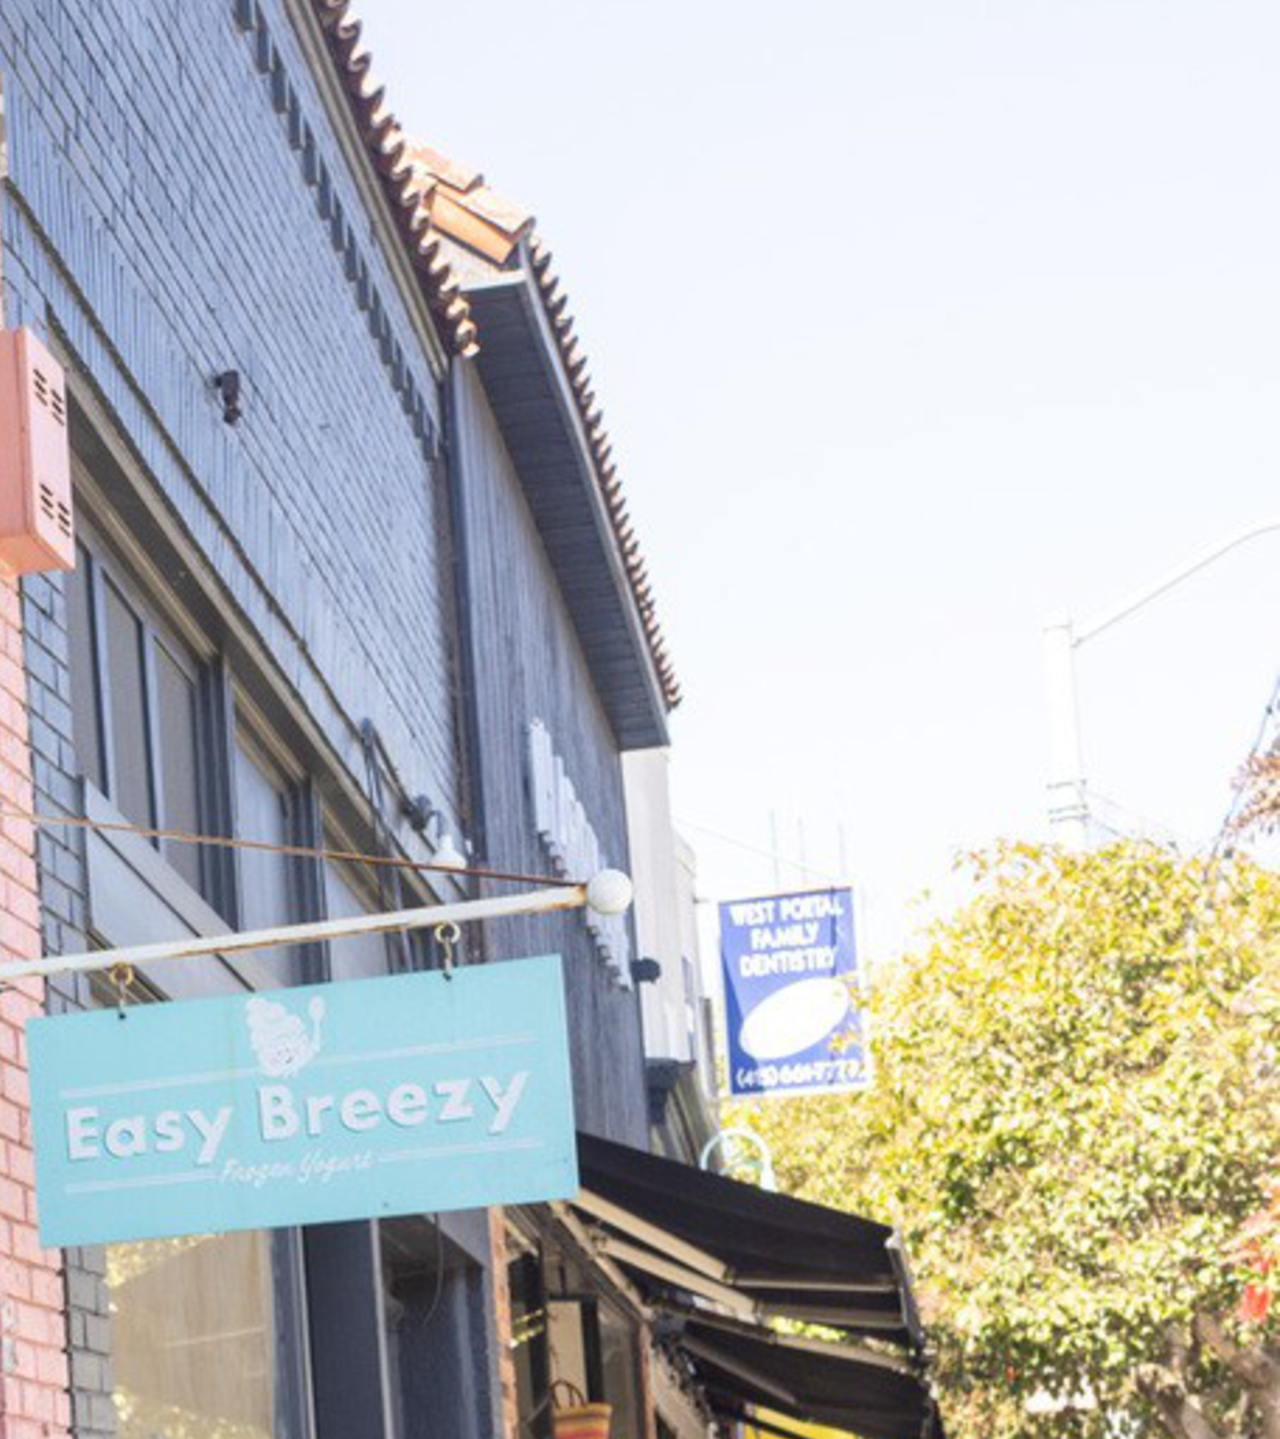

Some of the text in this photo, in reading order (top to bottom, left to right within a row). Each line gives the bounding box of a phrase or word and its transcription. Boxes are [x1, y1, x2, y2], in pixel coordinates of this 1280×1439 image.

[730, 894, 844, 927] WEST PORTAL
[751, 921, 820, 950] FAMILY
[739, 945, 838, 977] DENTISTRY
[63, 1070, 530, 1166] Easy Breezy
